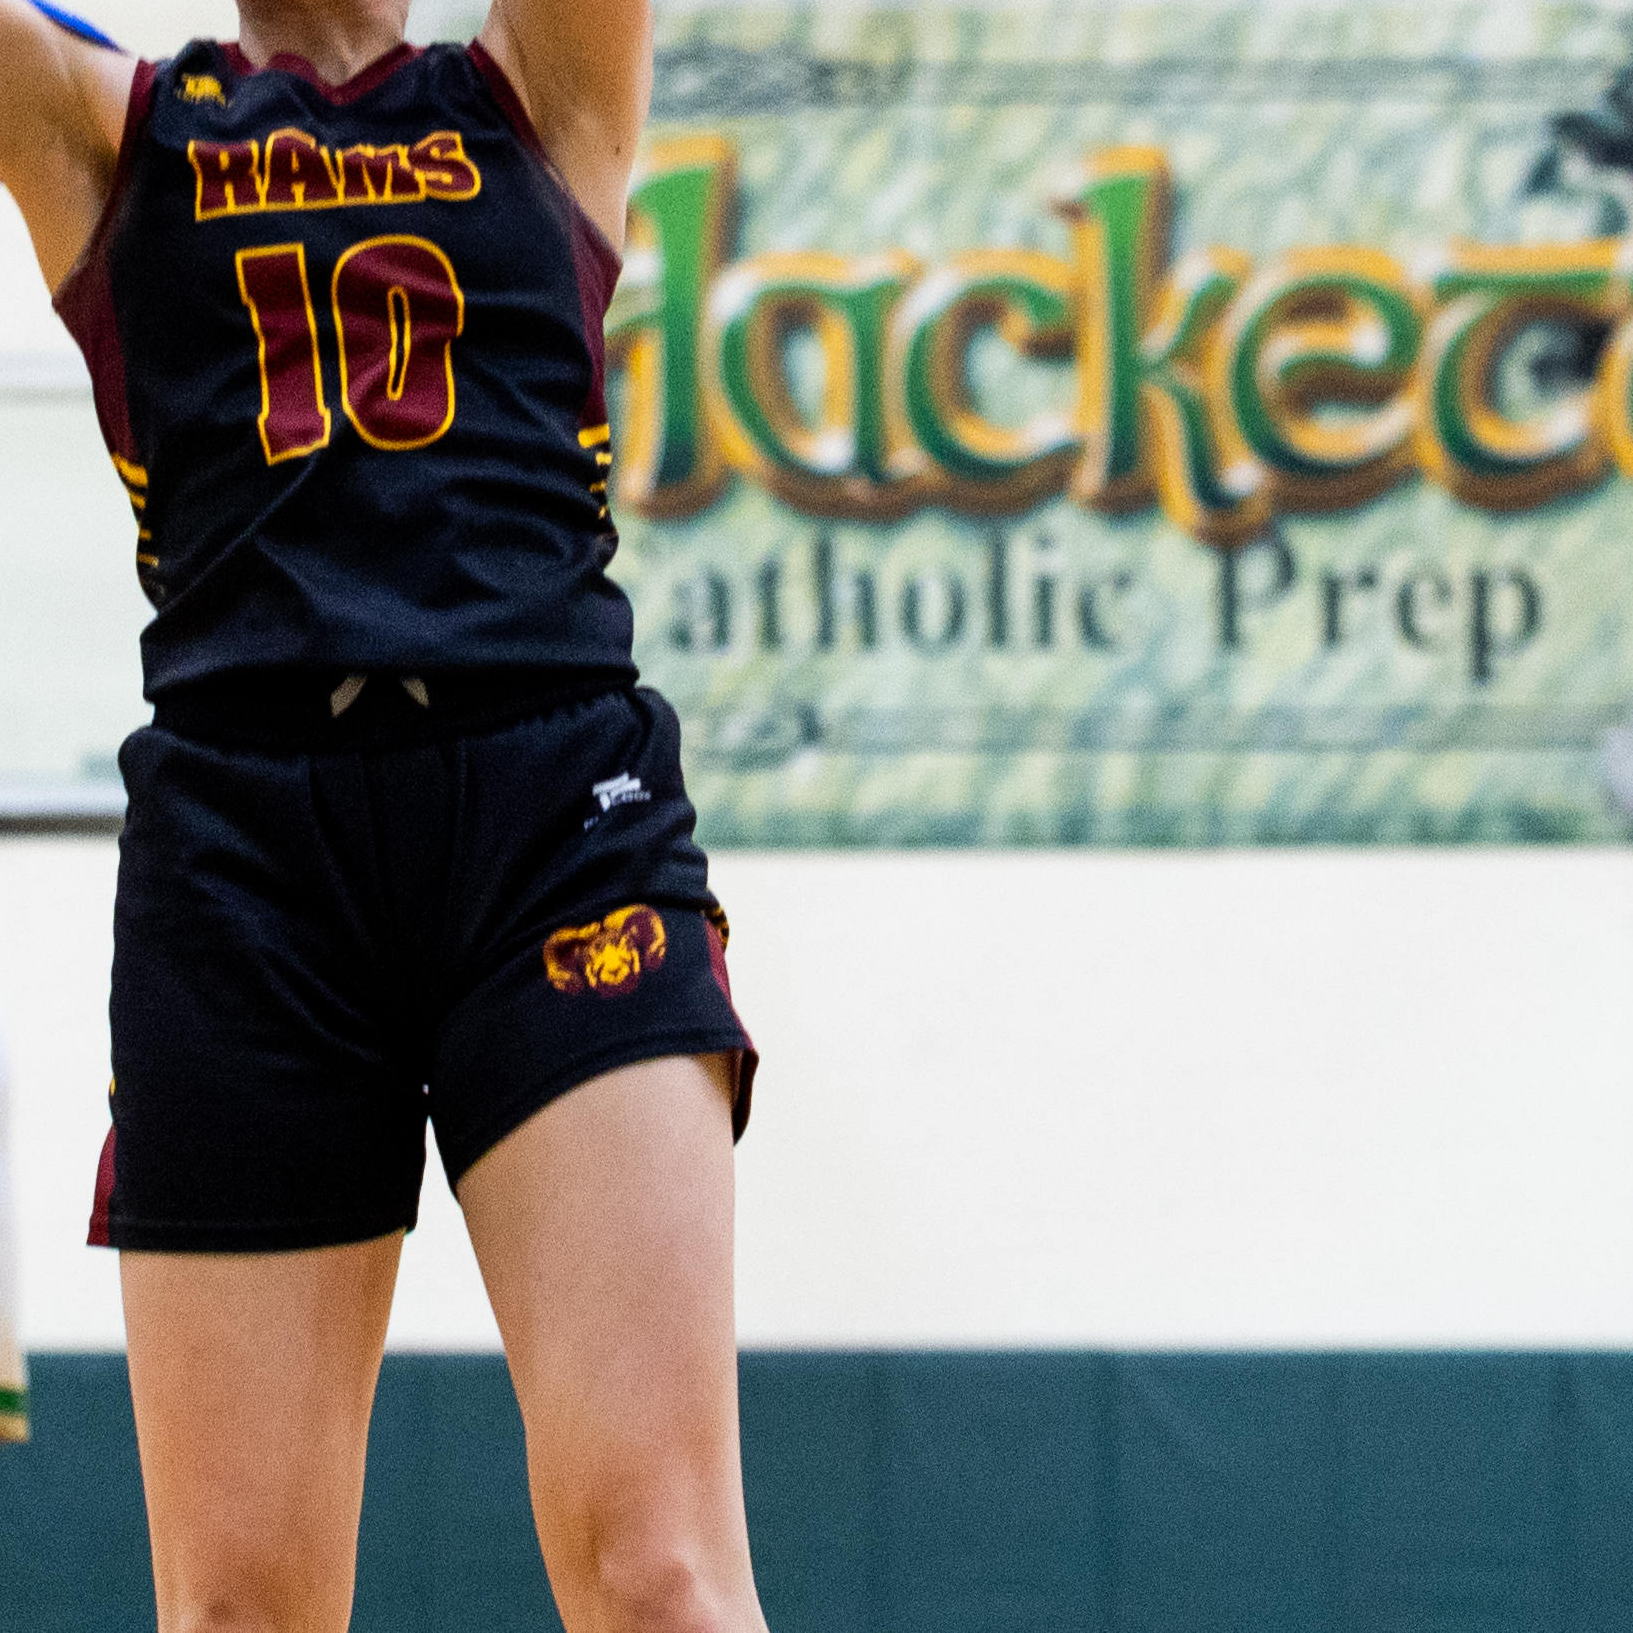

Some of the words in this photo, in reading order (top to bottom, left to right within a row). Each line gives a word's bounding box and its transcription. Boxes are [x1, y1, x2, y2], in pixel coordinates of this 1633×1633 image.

[187, 127, 482, 222] RAMS
[234, 233, 465, 466] 10
[668, 528, 1135, 656] atholic
[1216, 542, 1546, 688] Prep
